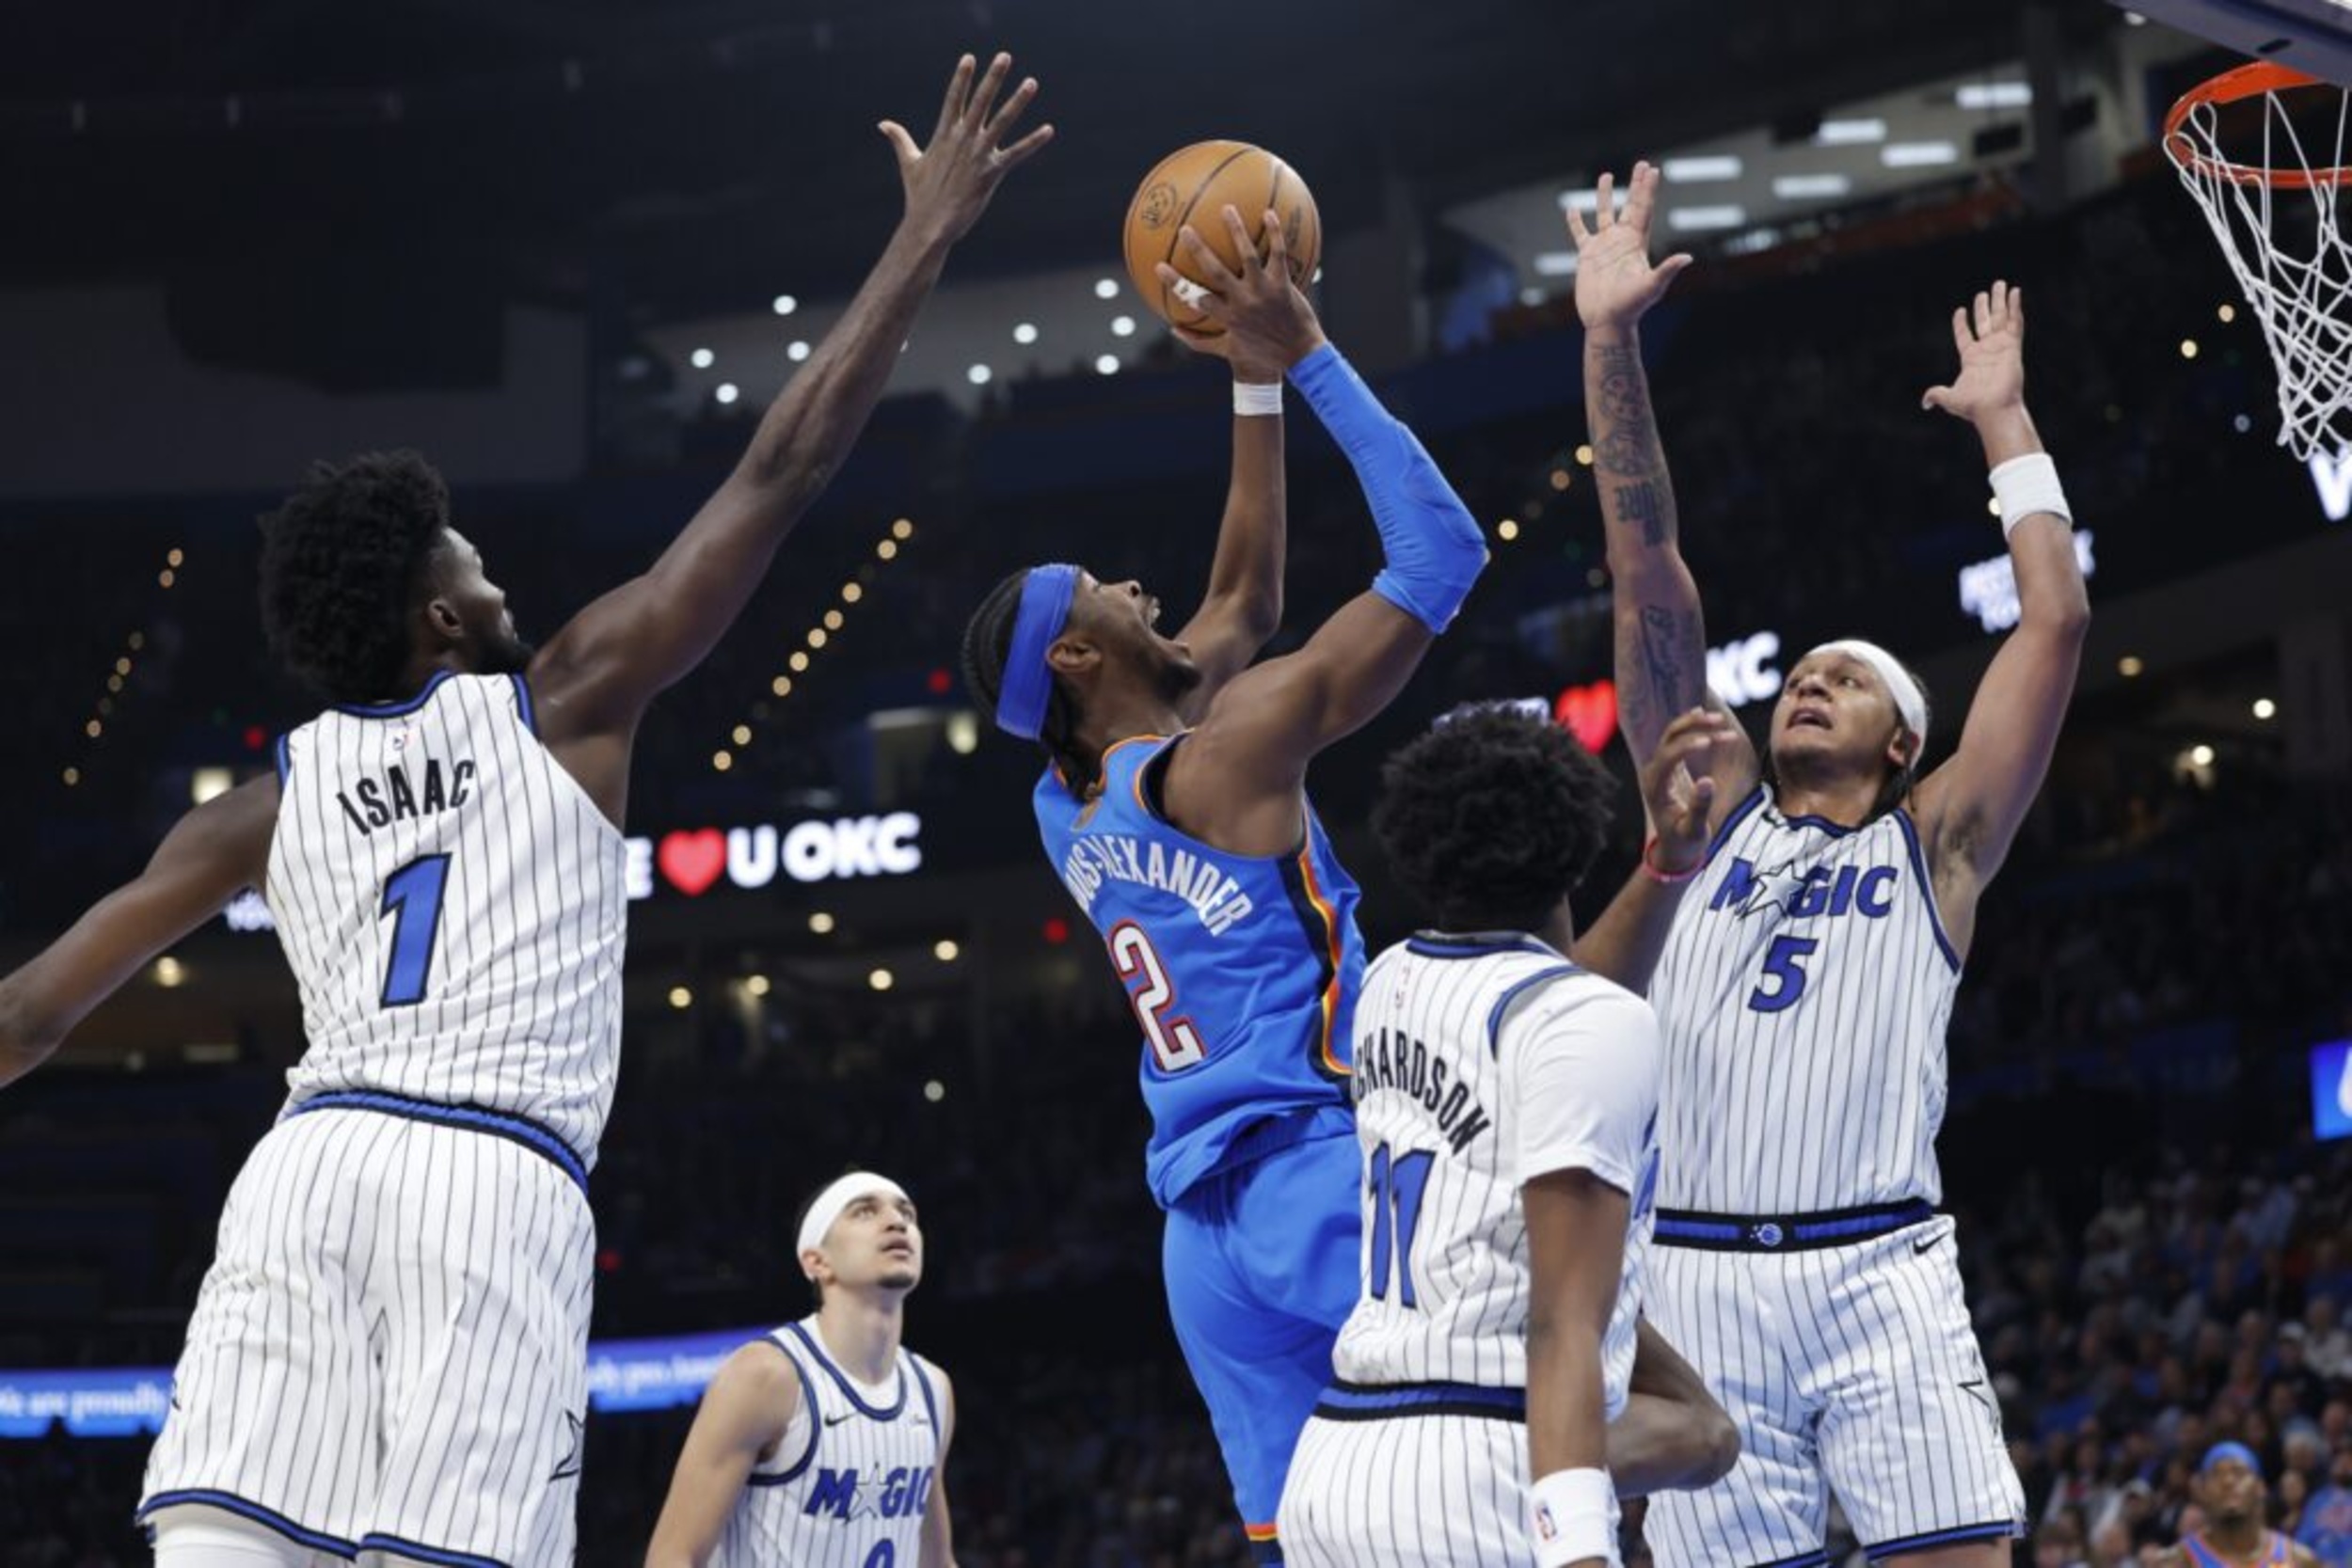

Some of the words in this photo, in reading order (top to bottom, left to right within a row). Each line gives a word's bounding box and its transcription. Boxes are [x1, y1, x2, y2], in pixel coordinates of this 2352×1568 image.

[1707, 631, 1782, 707] KC
[336, 758, 474, 836] ISAAC
[726, 824, 778, 888] U
[782, 812, 922, 882] OKC
[1708, 856, 1899, 920] MAGIC
[379, 852, 453, 1008] 1
[1107, 917, 1208, 1072] 2
[1747, 934, 1820, 1013] 5
[1369, 1139, 1437, 1310] 11
